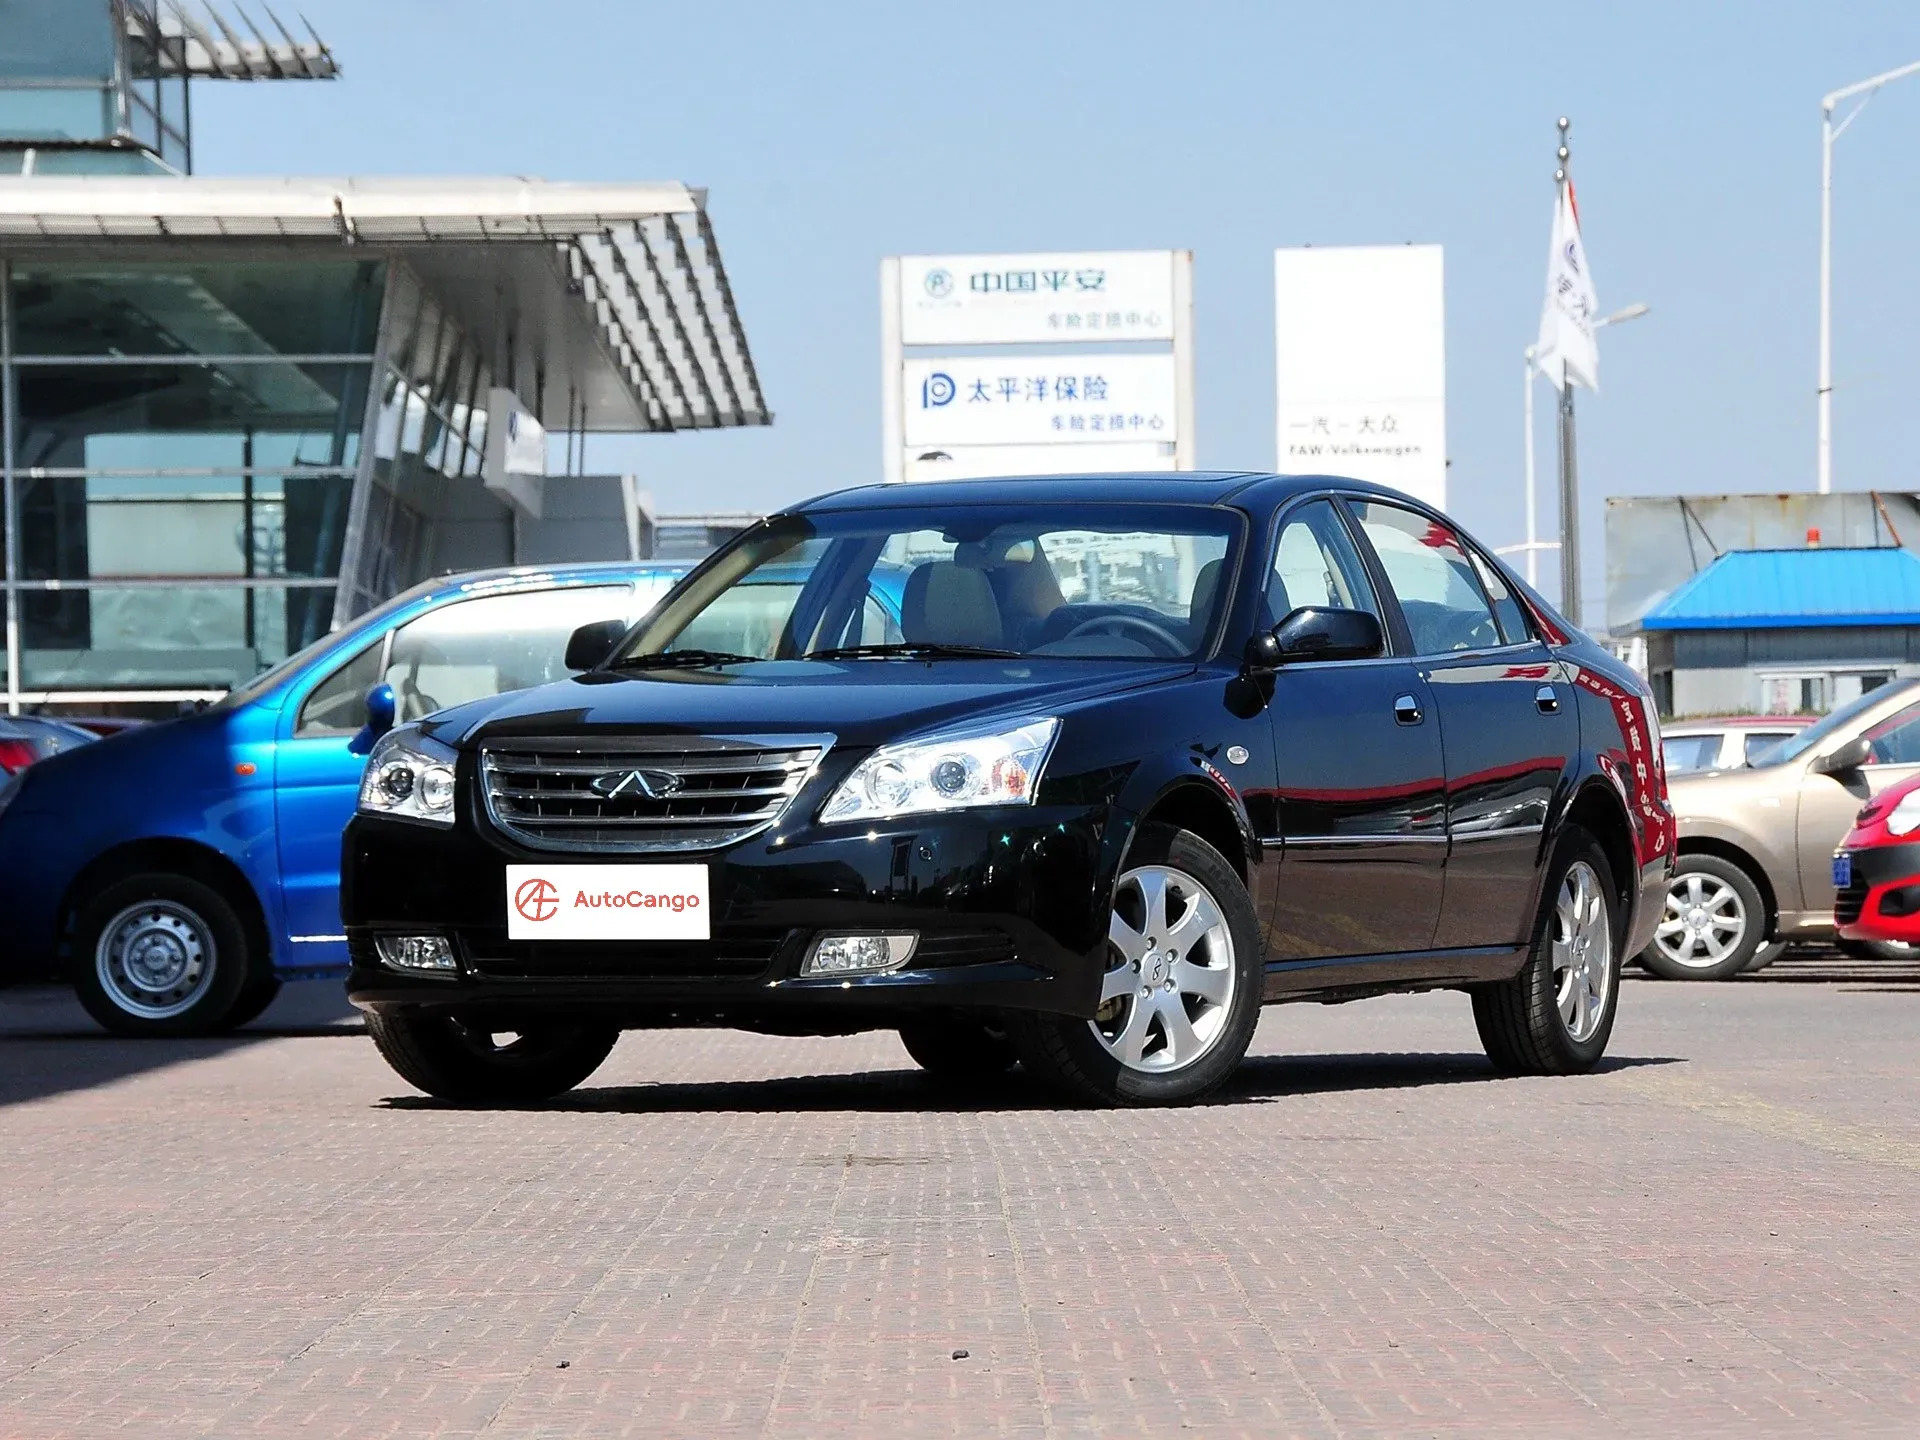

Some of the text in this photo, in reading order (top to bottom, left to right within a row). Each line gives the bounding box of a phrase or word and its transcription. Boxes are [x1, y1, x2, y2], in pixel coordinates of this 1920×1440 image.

[970, 269, 1106, 292] 中国平安
[967, 375, 1109, 402] 太平洋保险
